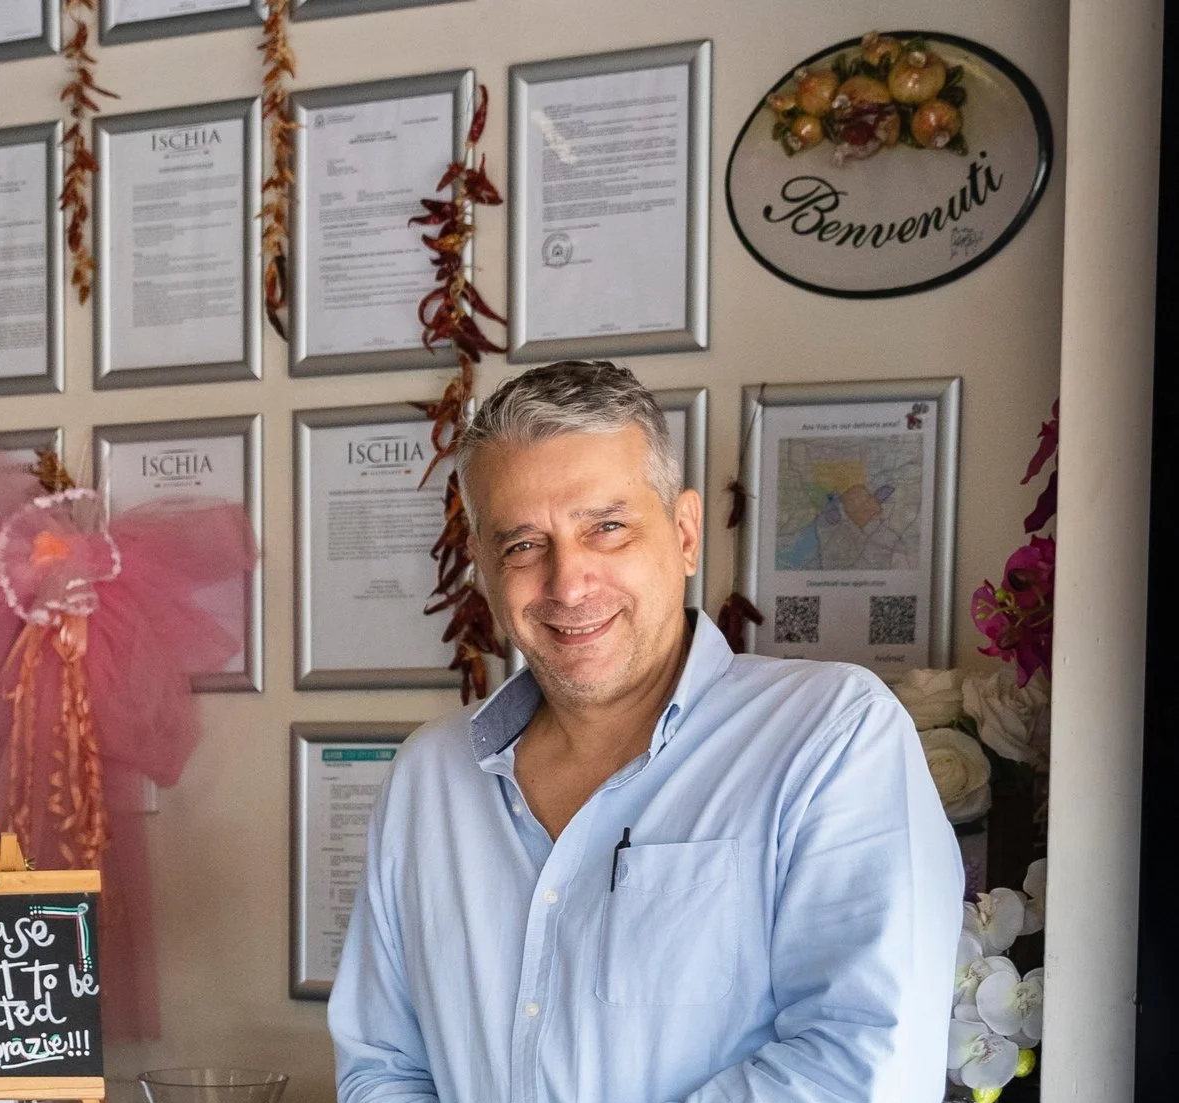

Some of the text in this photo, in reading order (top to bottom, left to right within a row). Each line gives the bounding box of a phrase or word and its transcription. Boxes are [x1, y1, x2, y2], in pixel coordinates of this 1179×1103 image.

[151, 128, 222, 152] ISCHIA
[763, 150, 1004, 249] Benvenuti
[142, 453, 213, 476] ISCHIA
[348, 440, 424, 465] ISCHIA
[68, 963, 100, 998] be
